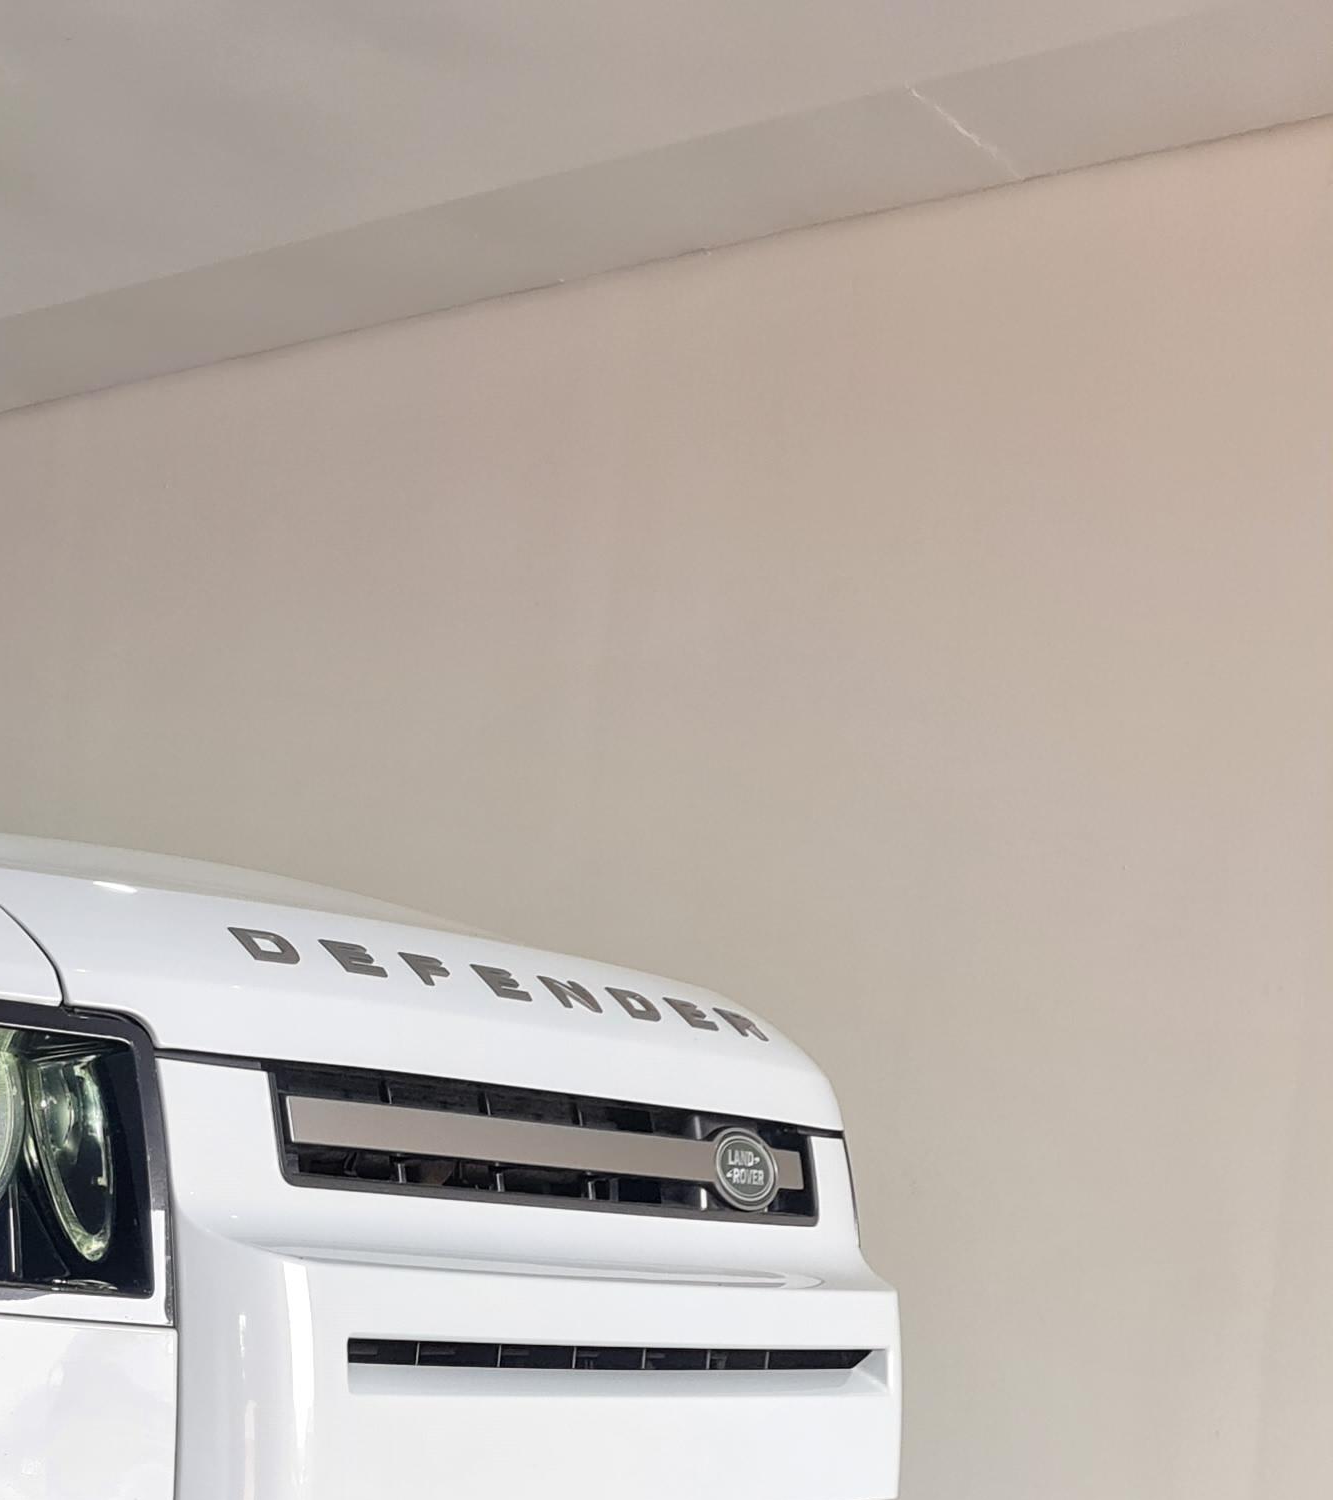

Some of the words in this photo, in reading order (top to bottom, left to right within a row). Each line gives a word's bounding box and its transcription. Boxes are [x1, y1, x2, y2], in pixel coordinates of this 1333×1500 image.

[228, 926, 769, 1042] DEFENDER
[727, 1149, 754, 1167] LAND
[732, 1168, 765, 1186] ROVER
